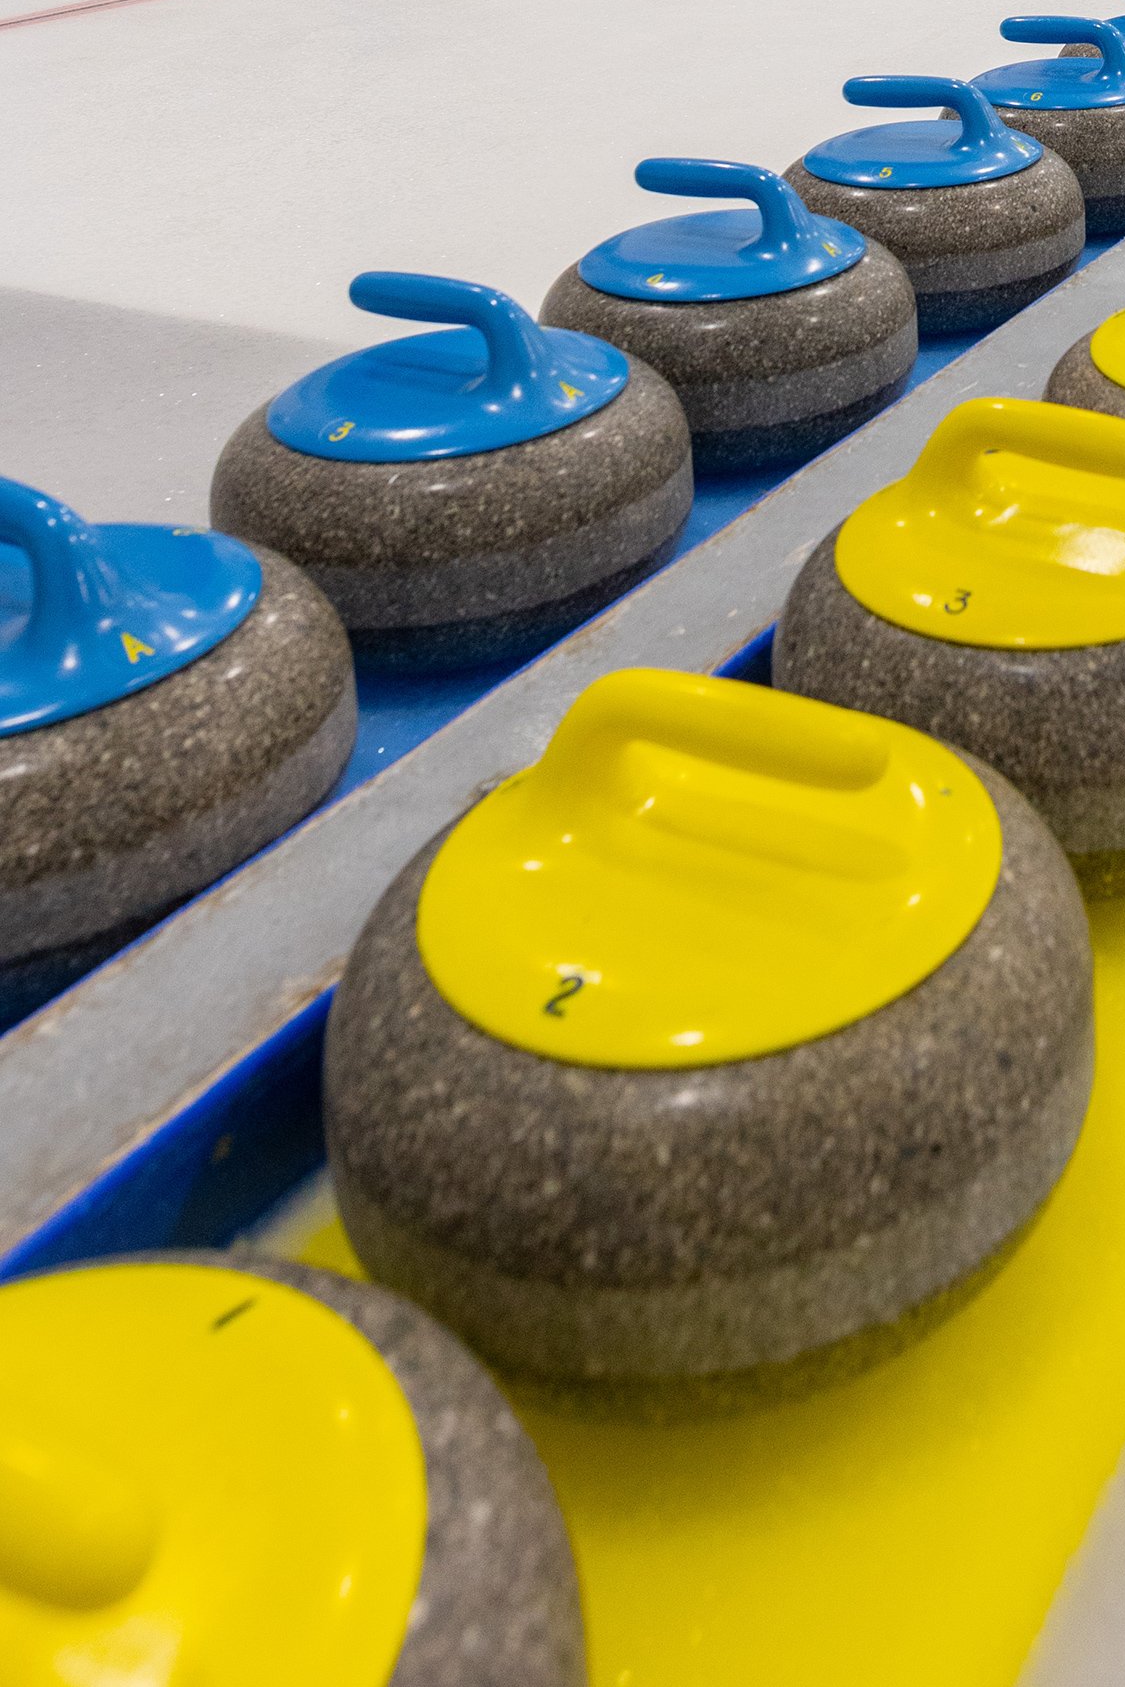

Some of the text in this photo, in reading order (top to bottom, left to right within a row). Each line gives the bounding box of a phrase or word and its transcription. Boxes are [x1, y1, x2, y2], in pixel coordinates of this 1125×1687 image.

[1031, 91, 1043, 101] 6
[879, 167, 894, 179] 5
[559, 380, 585, 401] A
[328, 421, 356, 443] 3
[944, 586, 972, 616] 3
[121, 631, 156, 665] A
[544, 974, 585, 1018] 2
